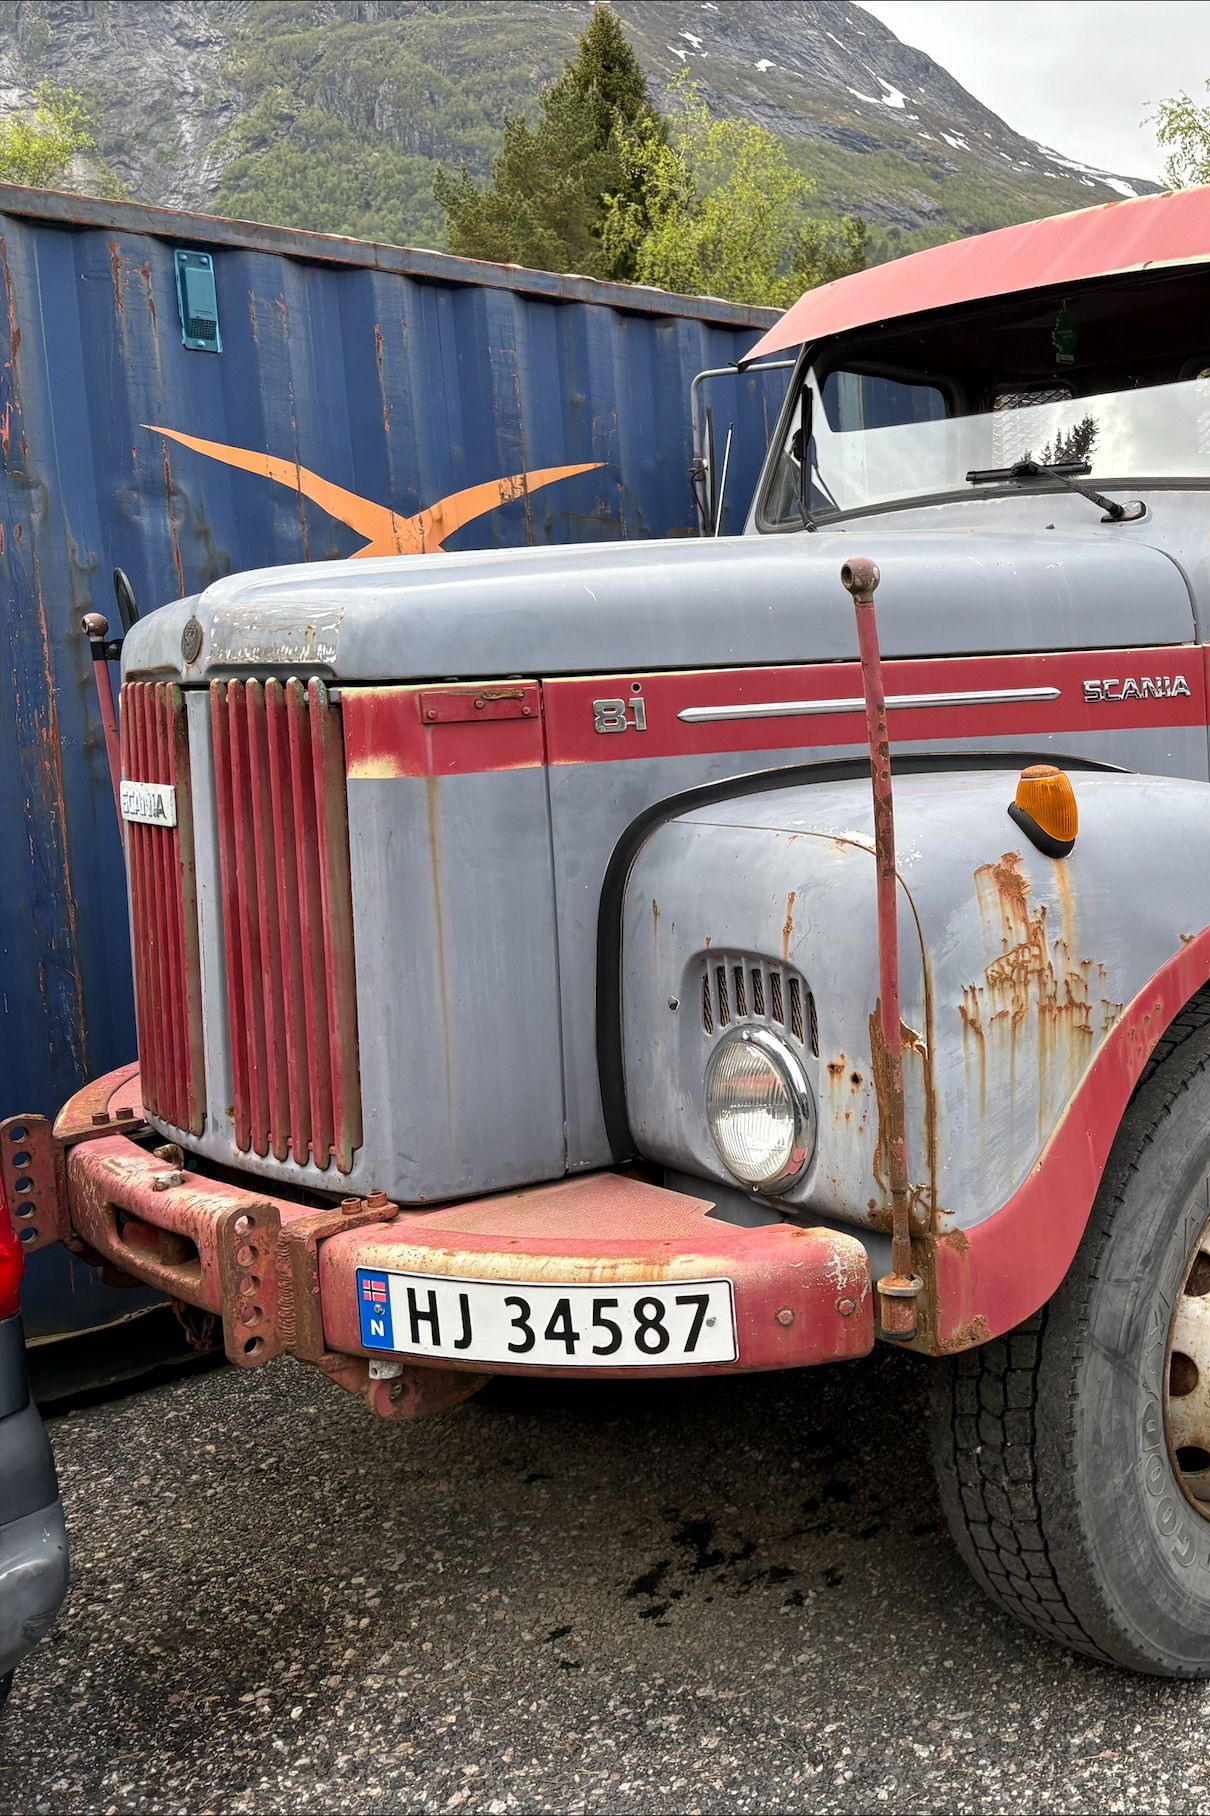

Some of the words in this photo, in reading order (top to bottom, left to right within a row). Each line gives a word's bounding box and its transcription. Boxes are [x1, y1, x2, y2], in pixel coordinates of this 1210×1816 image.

[1083, 675, 1191, 703] SCANIA
[369, 1319, 385, 1337] N
[406, 1287, 473, 1349] HJ
[503, 1293, 711, 1356] 34587
